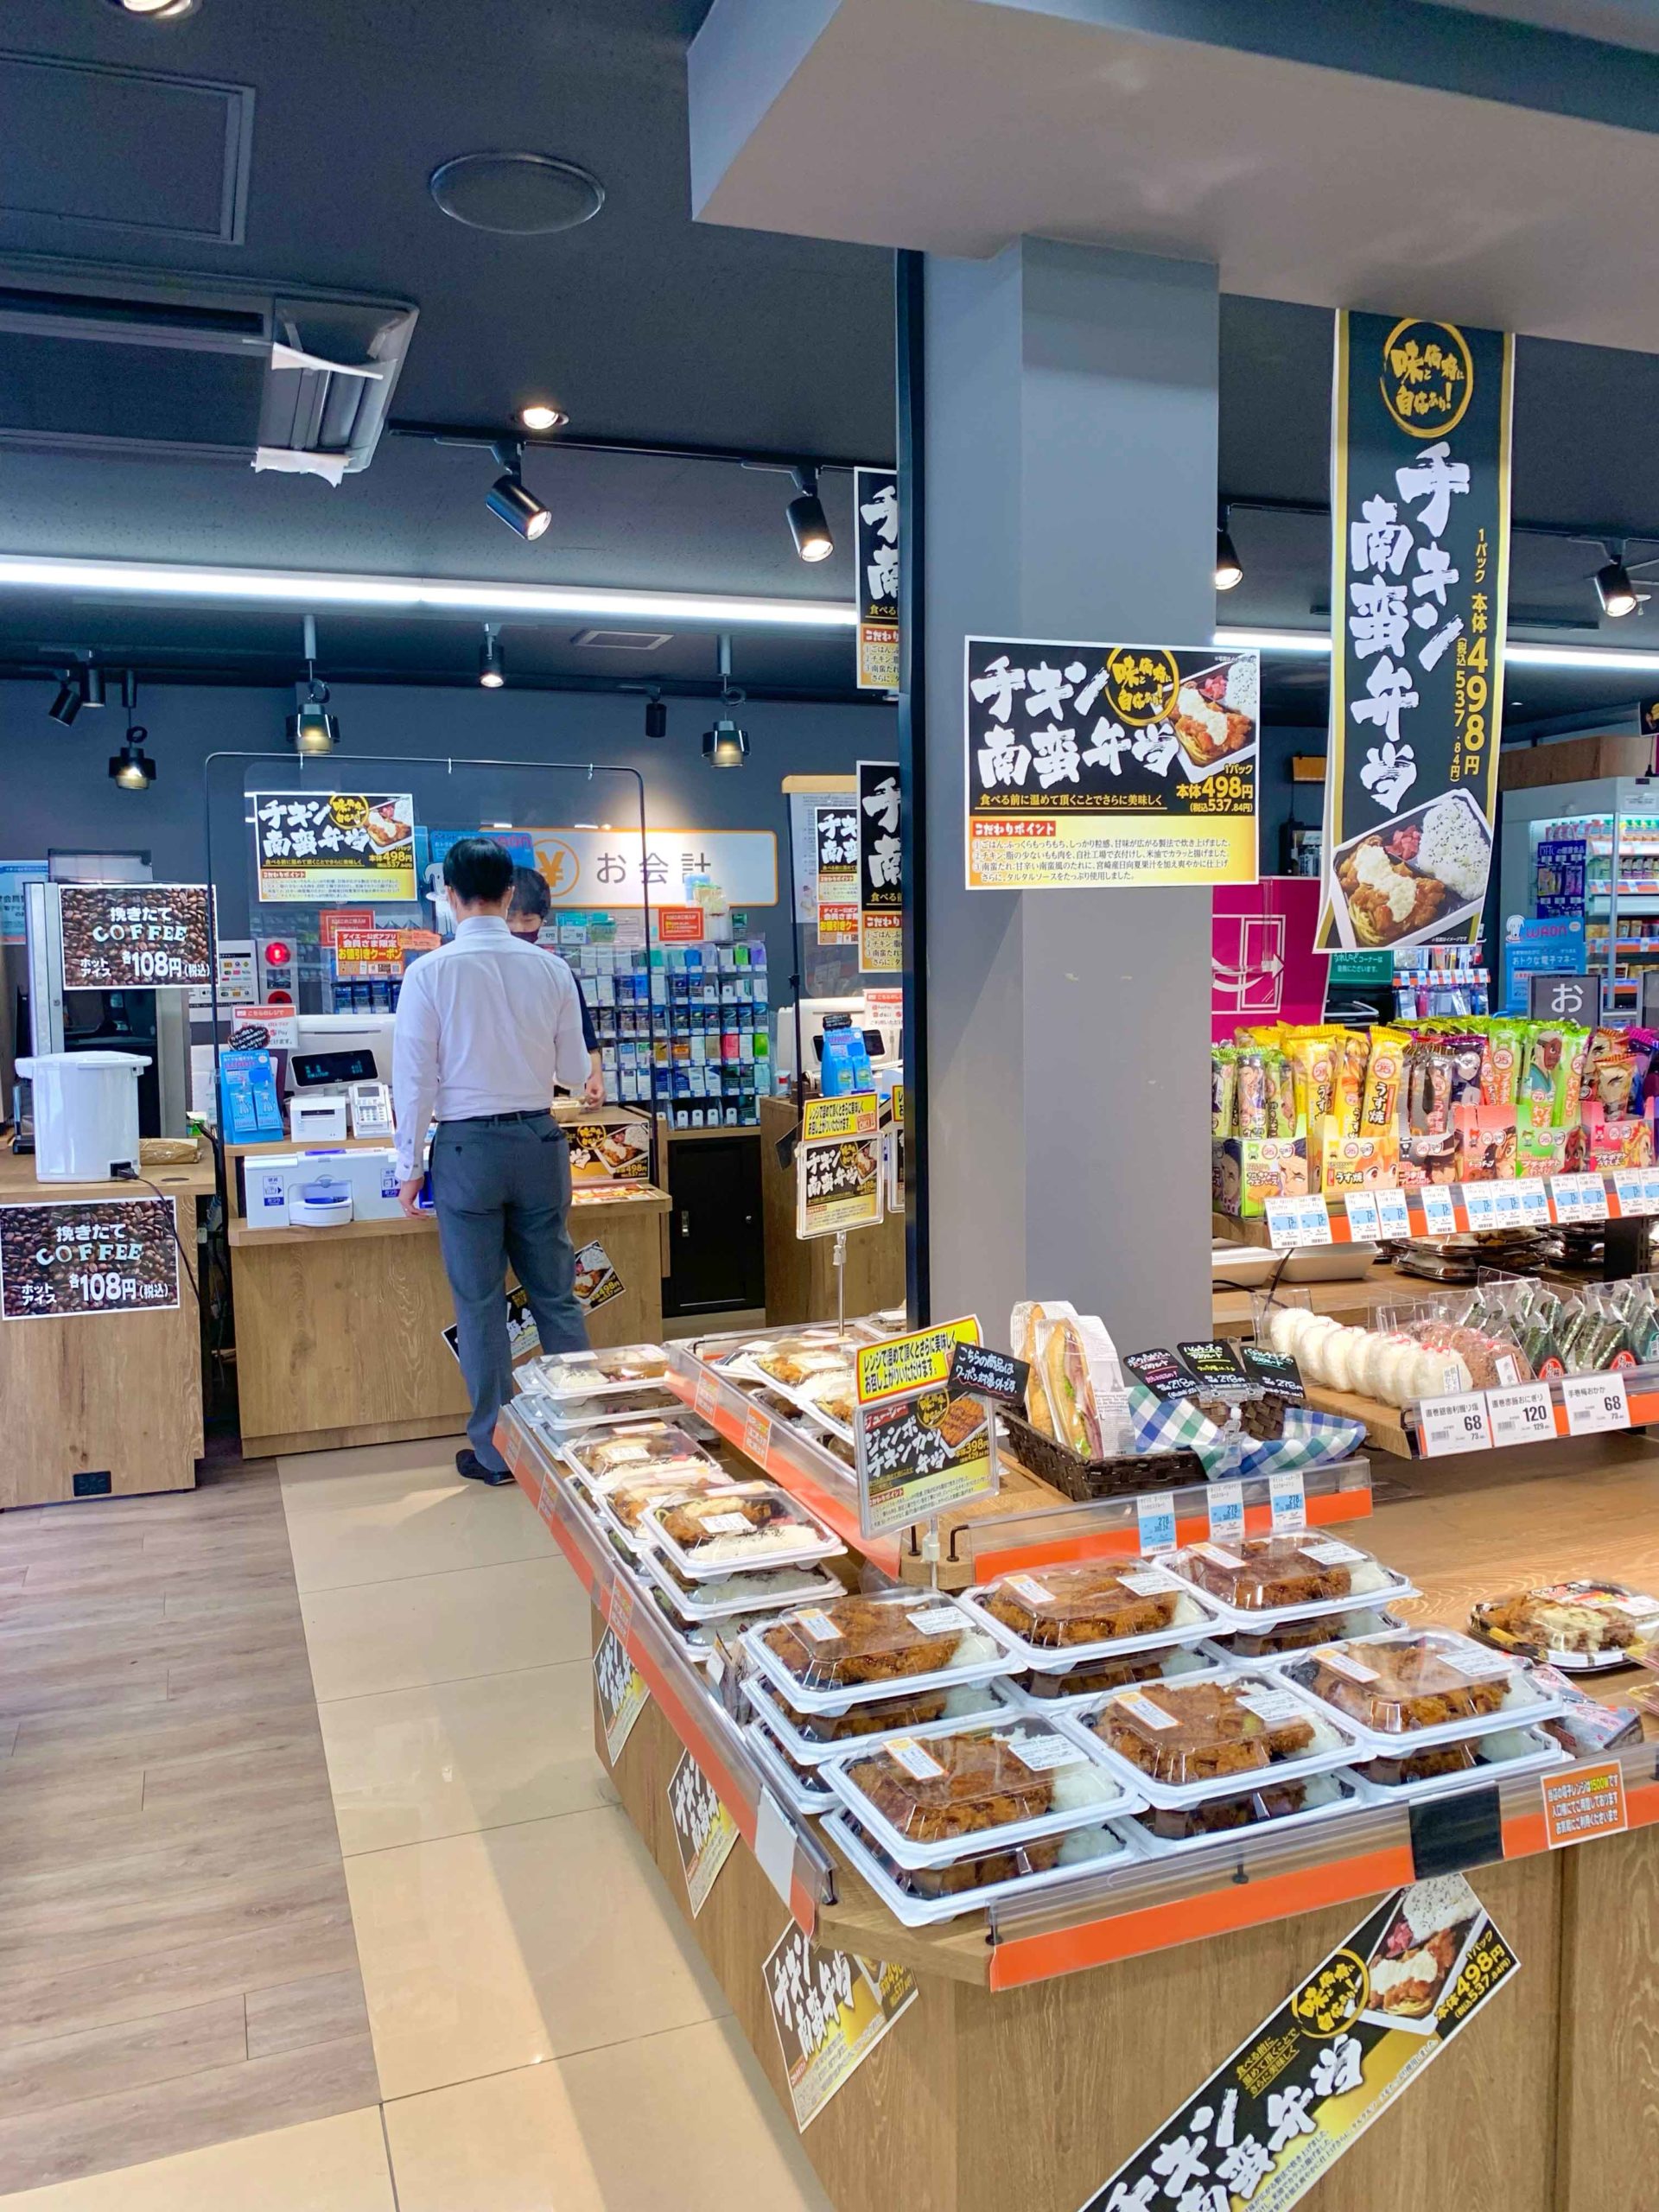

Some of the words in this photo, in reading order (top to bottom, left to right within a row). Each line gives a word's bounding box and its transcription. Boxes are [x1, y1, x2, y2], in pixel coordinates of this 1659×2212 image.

[1395, 441, 1470, 672] チキン
[1474, 529, 1488, 583] 1パック
[869, 604, 899, 615] 食べる
[1349, 493, 1420, 813] 南蛮弁当
[970, 655, 1110, 724] チキン
[1464, 593, 1489, 776] 本体498円
[977, 715, 1179, 790] 南蛮弁当
[1224, 763, 1254, 774] 1パック
[980, 793, 1162, 806] 食べる前に温めて頂くことでさらに美味しく
[1176, 775, 1254, 800] 本体498円
[258, 799, 332, 830] チキン
[263, 824, 370, 858] 南蛮弁当
[975, 822, 1055, 836] こだわりポイント
[596, 851, 712, 886] お会計
[110, 906, 173, 923] 挽きたて
[92, 924, 188, 943] COFFEE
[80, 957, 109, 969] ホット
[80, 968, 112, 978] アイス
[806, 1149, 841, 1175] チキン
[56, 1224, 126, 1243] 挽きたて
[35, 1243, 143, 1266] COFFEE
[21, 1283, 54, 1294] ホット
[22, 1294, 57, 1306] アイス
[864, 1330, 957, 1373] レンジで温めて頂くとさらに美味しく
[959, 1346, 1014, 1375] こちらの商品は
[865, 1358, 938, 1394] お召し上がりいただけます。
[1522, 1405, 1548, 1423] 120
[1604, 1395, 1622, 1412] 68
[1464, 1414, 1482, 1432] 68
[866, 1415, 918, 1457] ジャンボ
[867, 1428, 942, 1478] チキンカツ
[915, 1449, 946, 1474] 弁当
[609, 1650, 639, 1716] 南蛮弁
[1434, 1944, 1506, 2020] 本体498円
